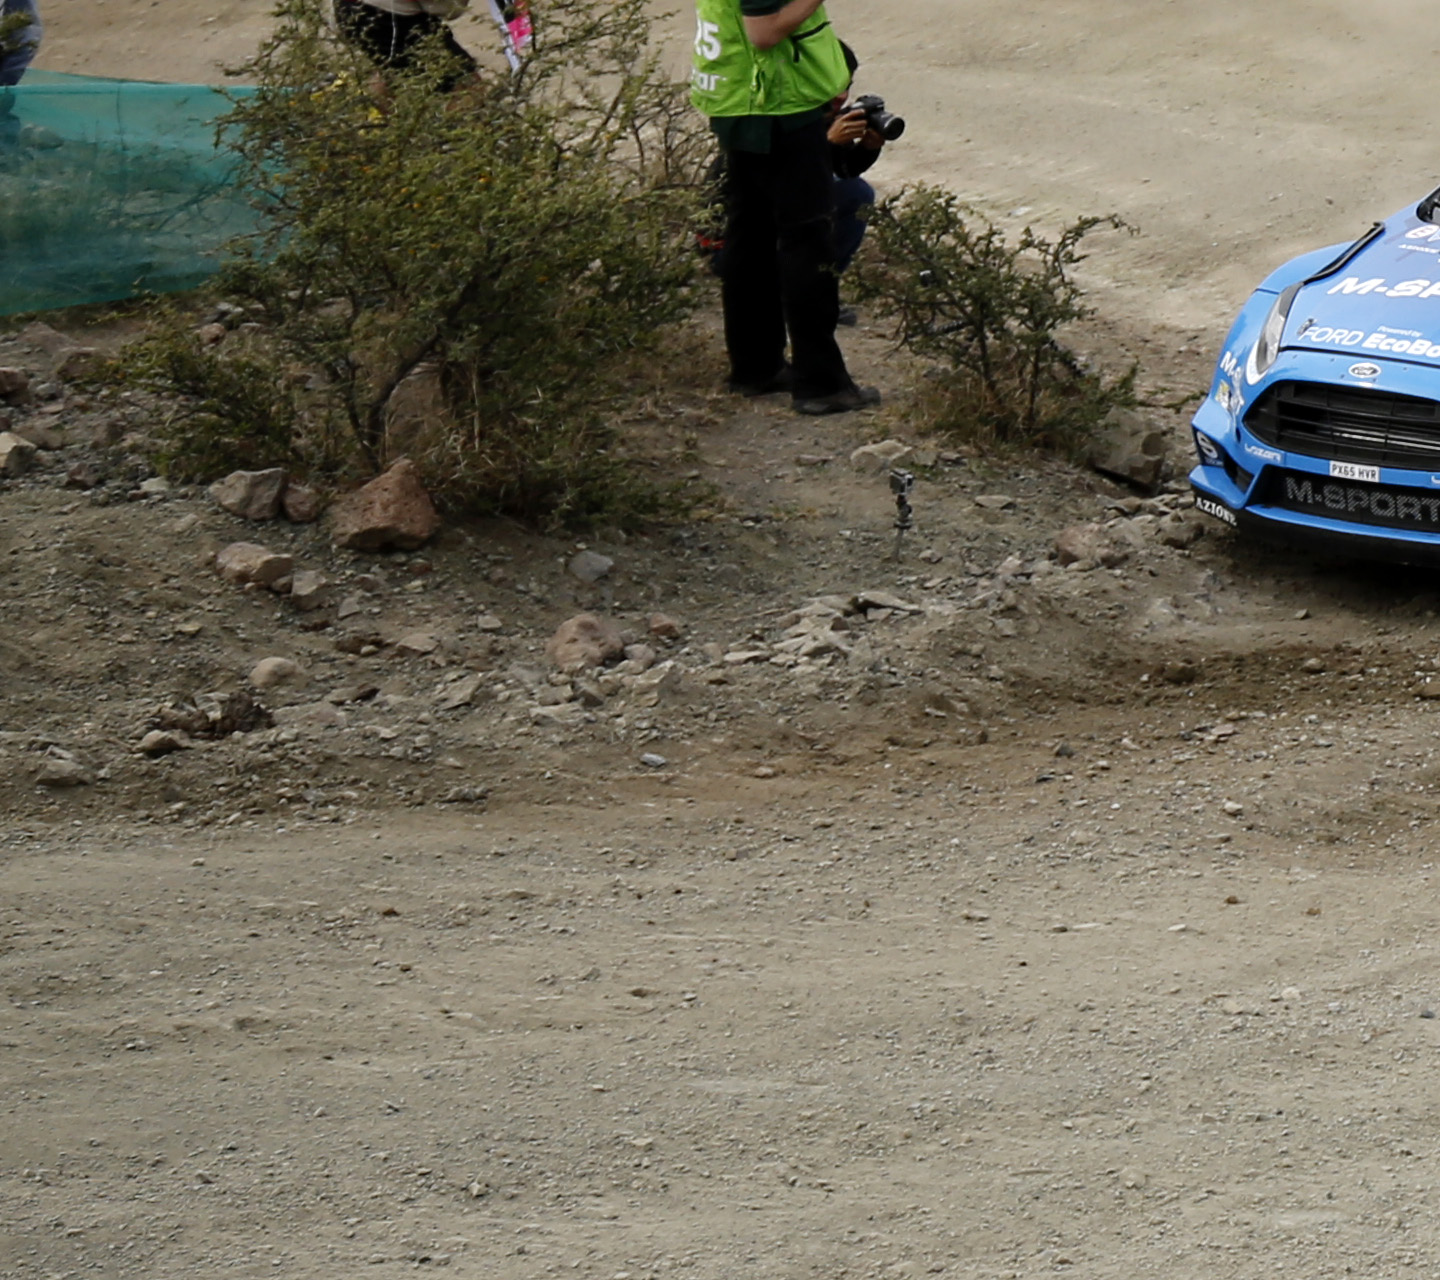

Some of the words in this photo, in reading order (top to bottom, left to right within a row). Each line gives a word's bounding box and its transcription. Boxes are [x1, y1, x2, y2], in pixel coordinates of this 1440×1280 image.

[1298, 327, 1365, 347] FORD
[1377, 325, 1408, 337] Powered
[1332, 462, 1356, 477] PX65
[1358, 466, 1377, 480] HVR
[1194, 497, 1237, 527] AZIONE
